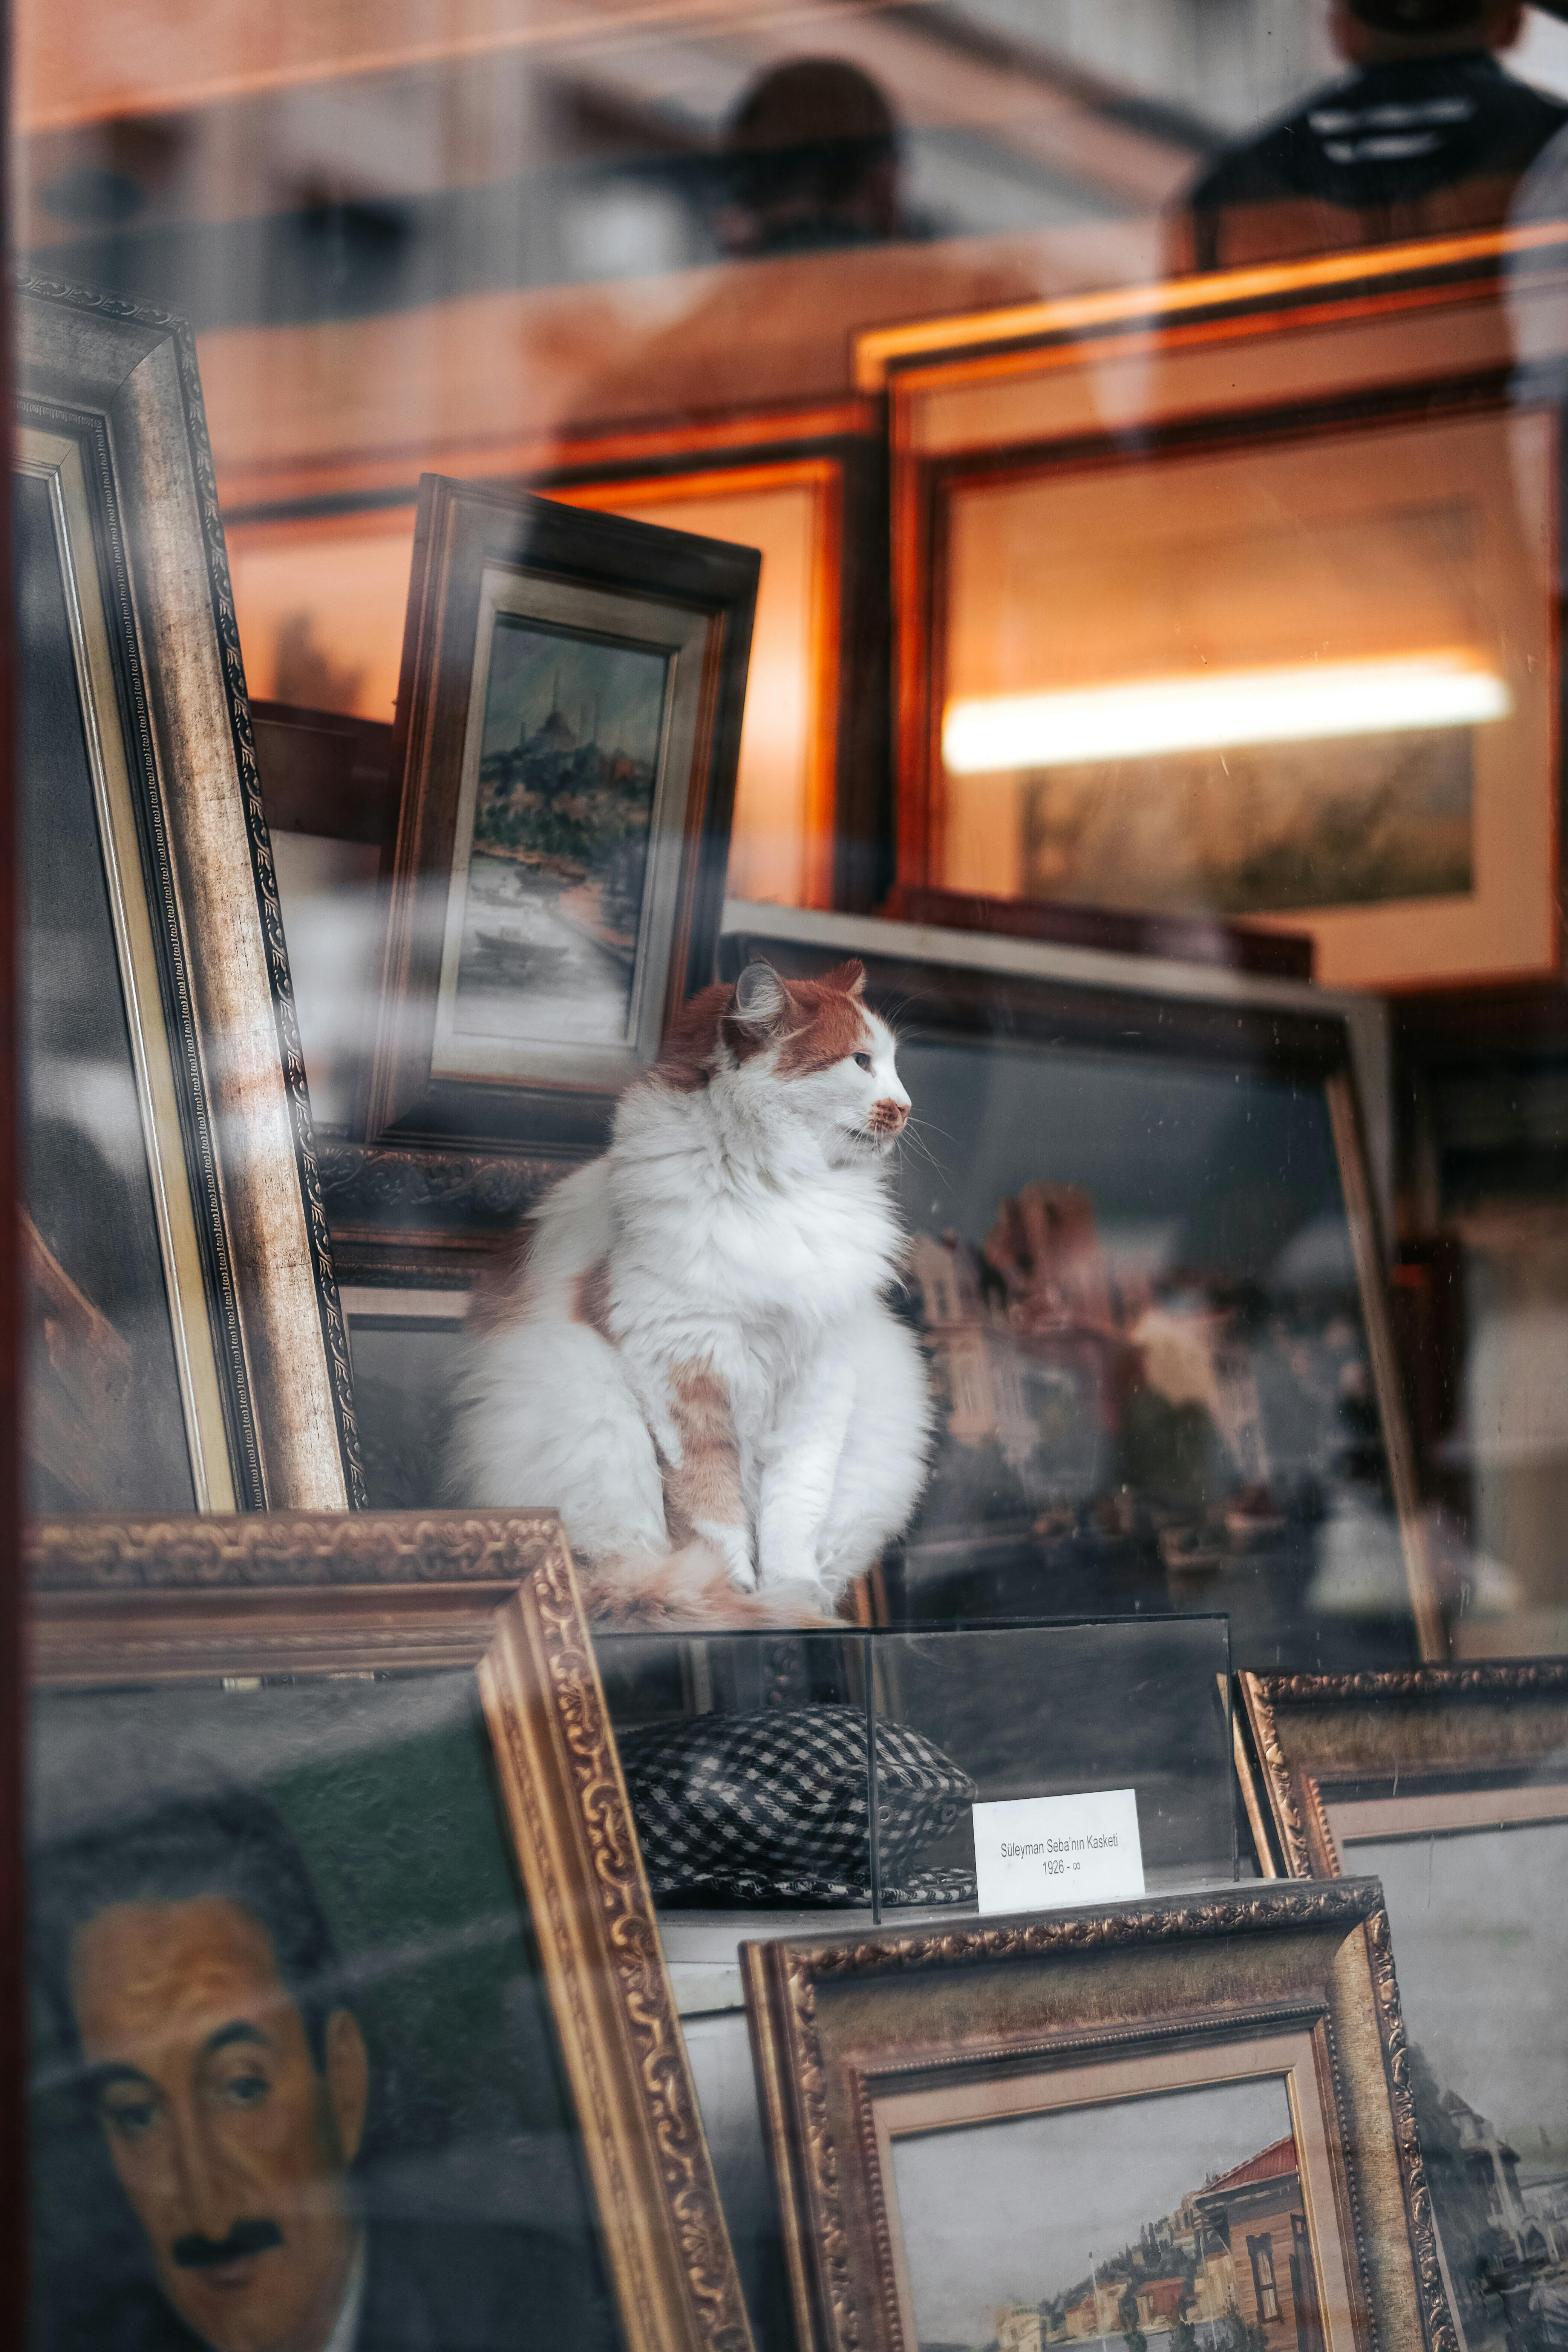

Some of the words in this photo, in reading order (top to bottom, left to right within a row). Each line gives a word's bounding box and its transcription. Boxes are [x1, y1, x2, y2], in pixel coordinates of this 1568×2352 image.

[1001, 1842, 1044, 1859] Süleyman
[1047, 1837, 1084, 1853] Seba'nın
[1087, 1833, 1118, 1849] Kasketi
[1043, 1859, 1064, 1875] 1926
